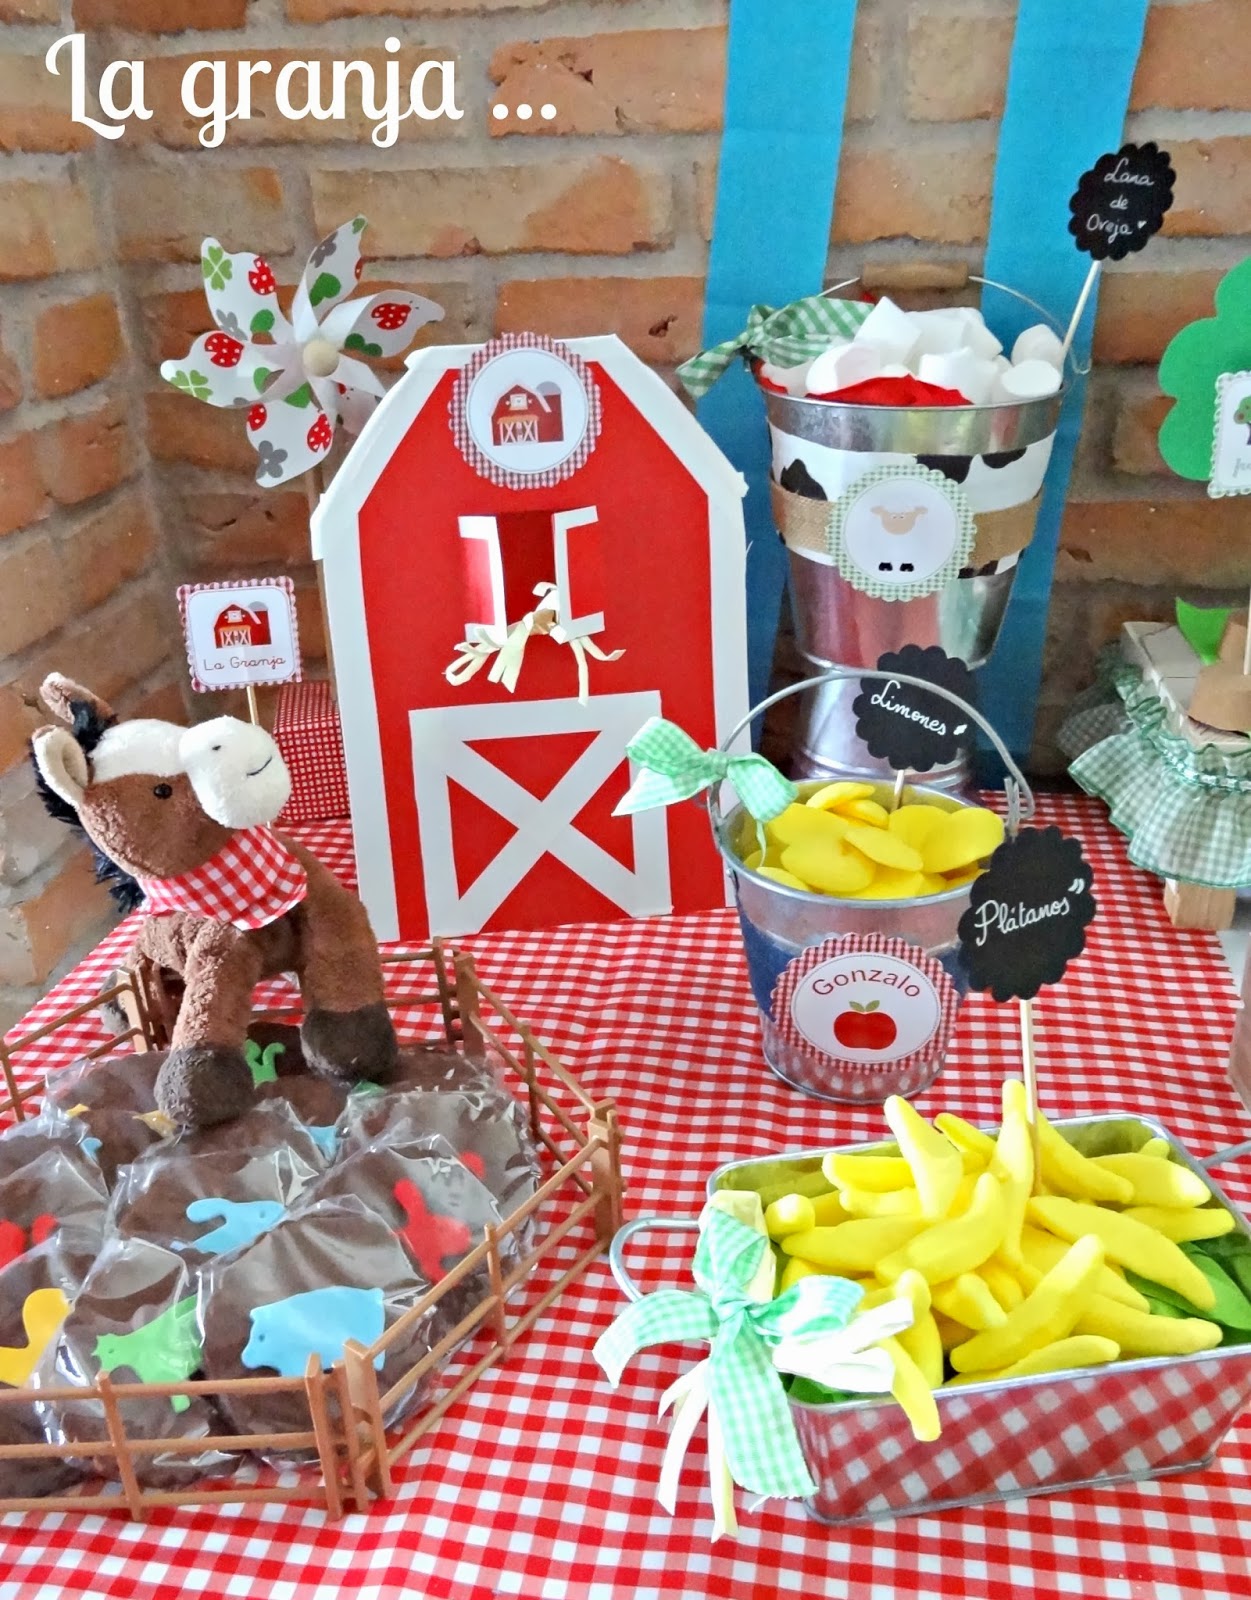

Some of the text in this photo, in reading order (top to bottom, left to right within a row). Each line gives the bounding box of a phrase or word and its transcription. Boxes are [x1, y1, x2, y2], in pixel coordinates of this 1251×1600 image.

[1103, 157, 1155, 186] Lana
[1109, 193, 1129, 210] de
[1086, 213, 1133, 244] Oveja
[203, 656, 286, 671] La Granja
[870, 680, 947, 736] Limones
[974, 897, 1070, 947] Plátanos
[812, 969, 920, 997] Gonzalo
